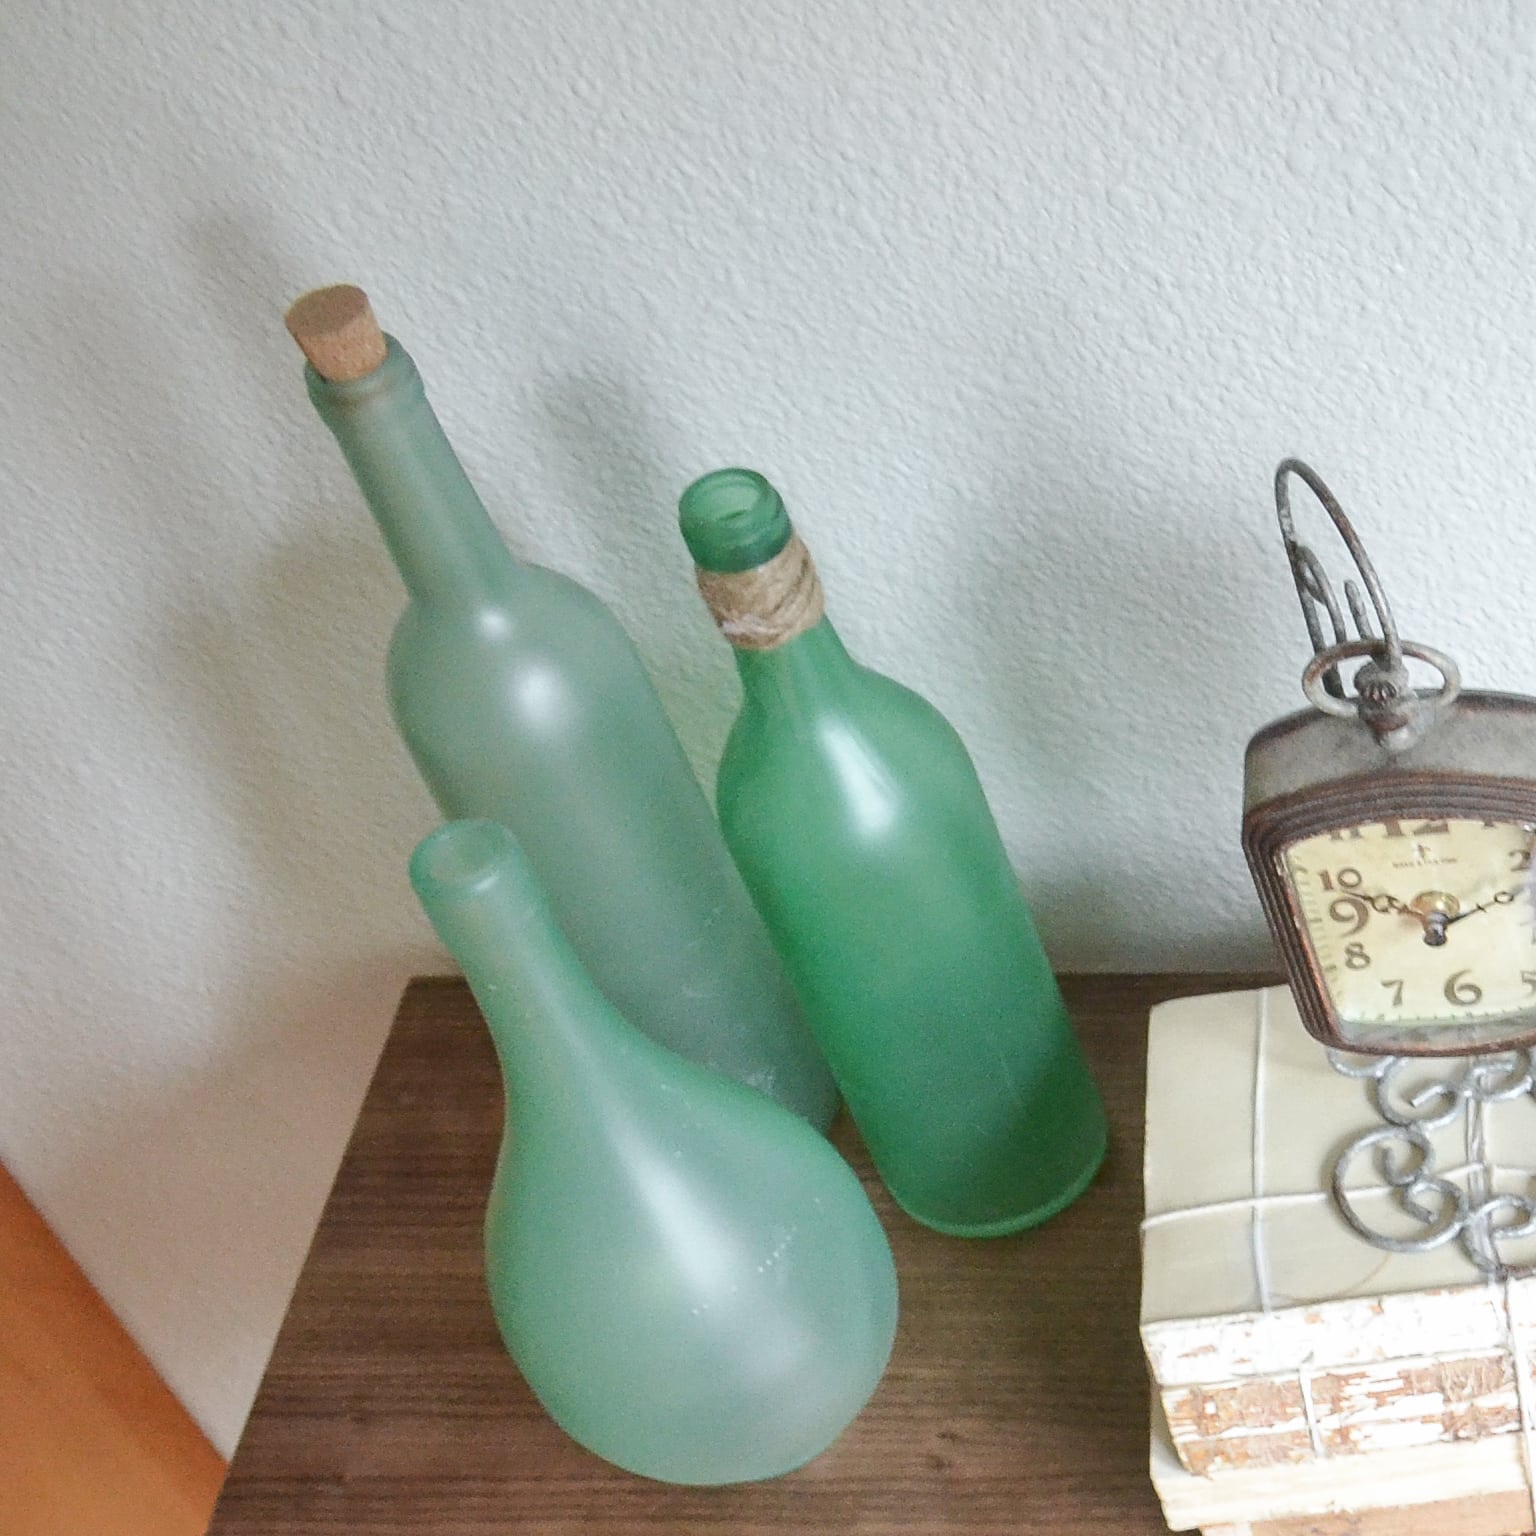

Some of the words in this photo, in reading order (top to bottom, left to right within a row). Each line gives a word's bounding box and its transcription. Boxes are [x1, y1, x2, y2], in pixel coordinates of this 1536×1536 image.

[1317, 867, 1362, 891] 10
[1329, 897, 1369, 937] 9
[1344, 942, 1371, 969] 8
[1380, 979, 1405, 1007] 7
[1443, 969, 1483, 1006] 6
